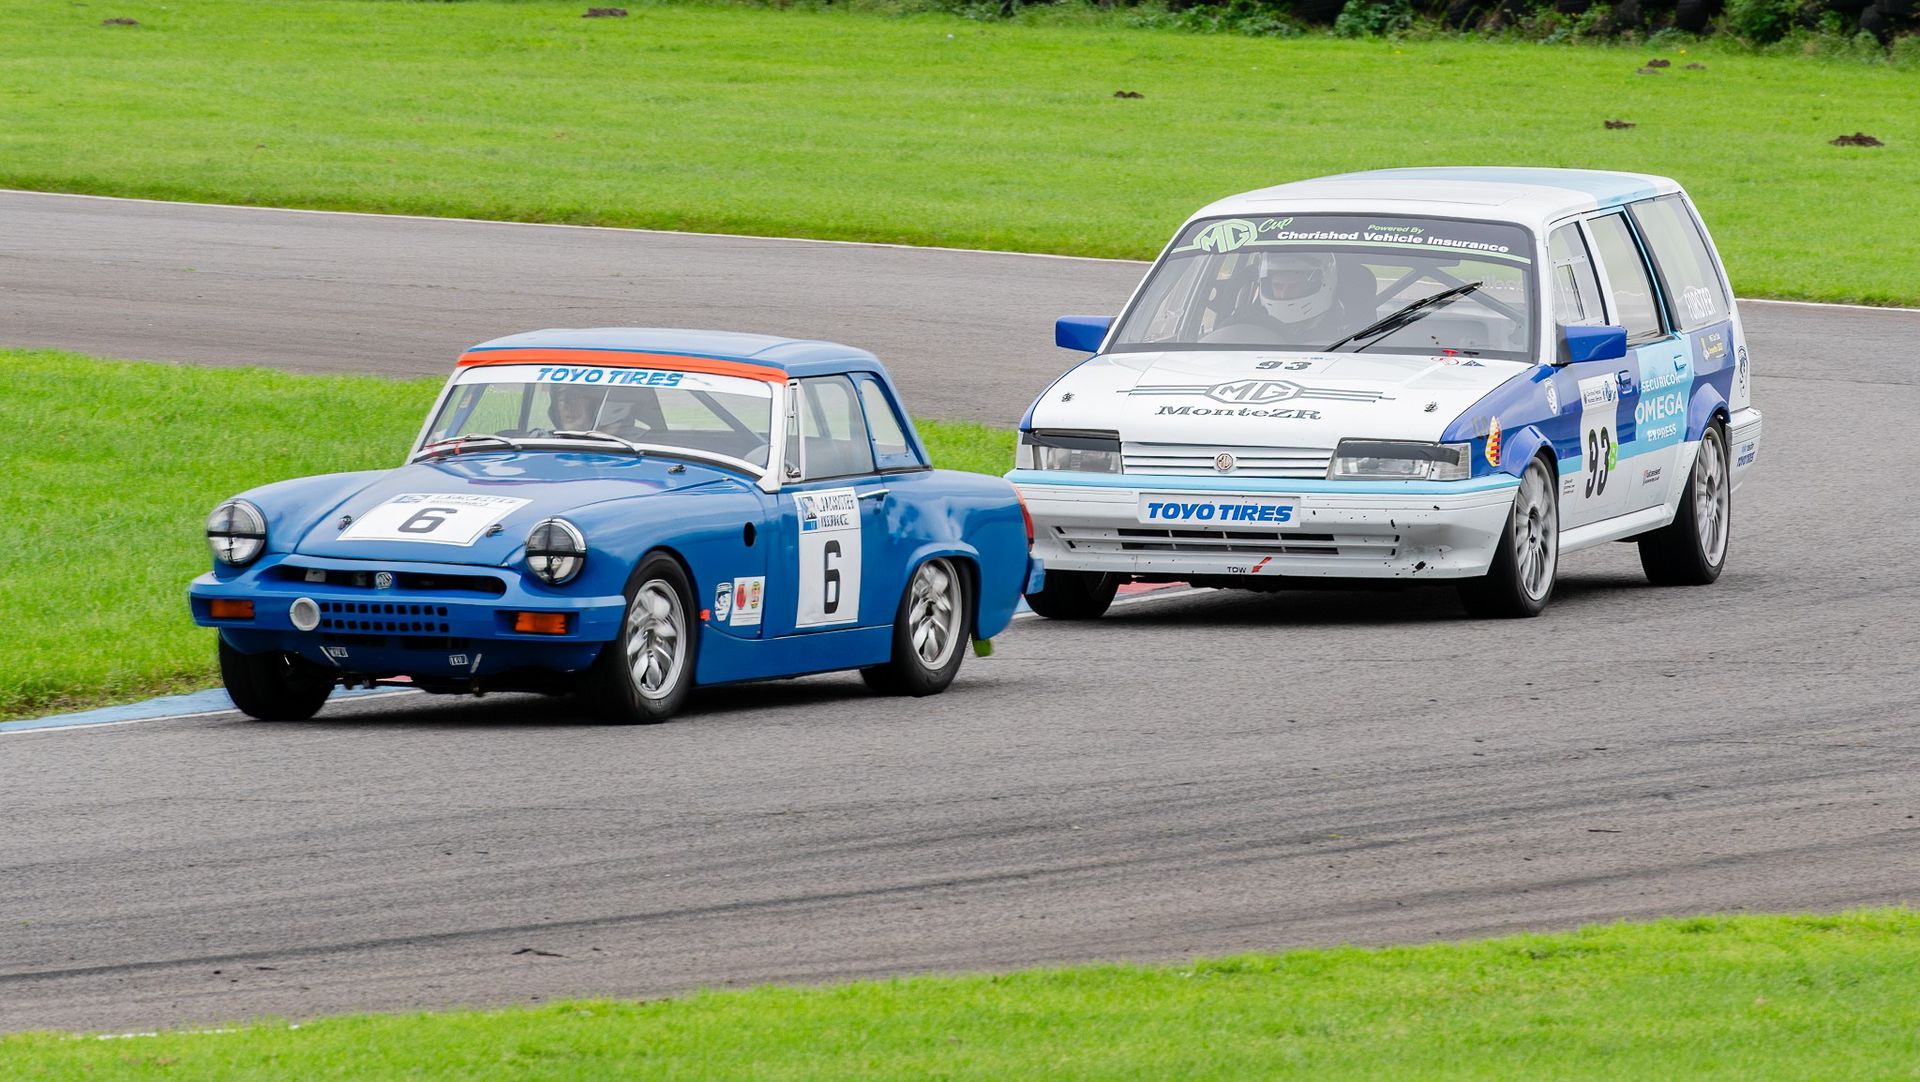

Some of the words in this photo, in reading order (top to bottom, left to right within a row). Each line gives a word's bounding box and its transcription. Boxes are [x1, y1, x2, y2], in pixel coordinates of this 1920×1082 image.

[1258, 217, 1293, 232] Cup
[1368, 224, 1408, 232] Powered
[1410, 225, 1424, 234] By
[1277, 231, 1358, 240] Cherished
[1363, 232, 1423, 243] Vehicle
[1427, 236, 1509, 253] Insurance
[1255, 360, 1312, 370] 93
[537, 367, 603, 382] TOYO
[608, 370, 684, 387] TIRES
[1154, 405, 1321, 420] MonteZR
[1635, 392, 1684, 425] OMEGA
[1647, 423, 1677, 441] EXPRESS
[1585, 426, 1610, 499] 93
[398, 507, 458, 534] 6
[1147, 502, 1215, 520] TOYO
[1219, 504, 1293, 522] TIRES
[824, 540, 841, 614] 6
